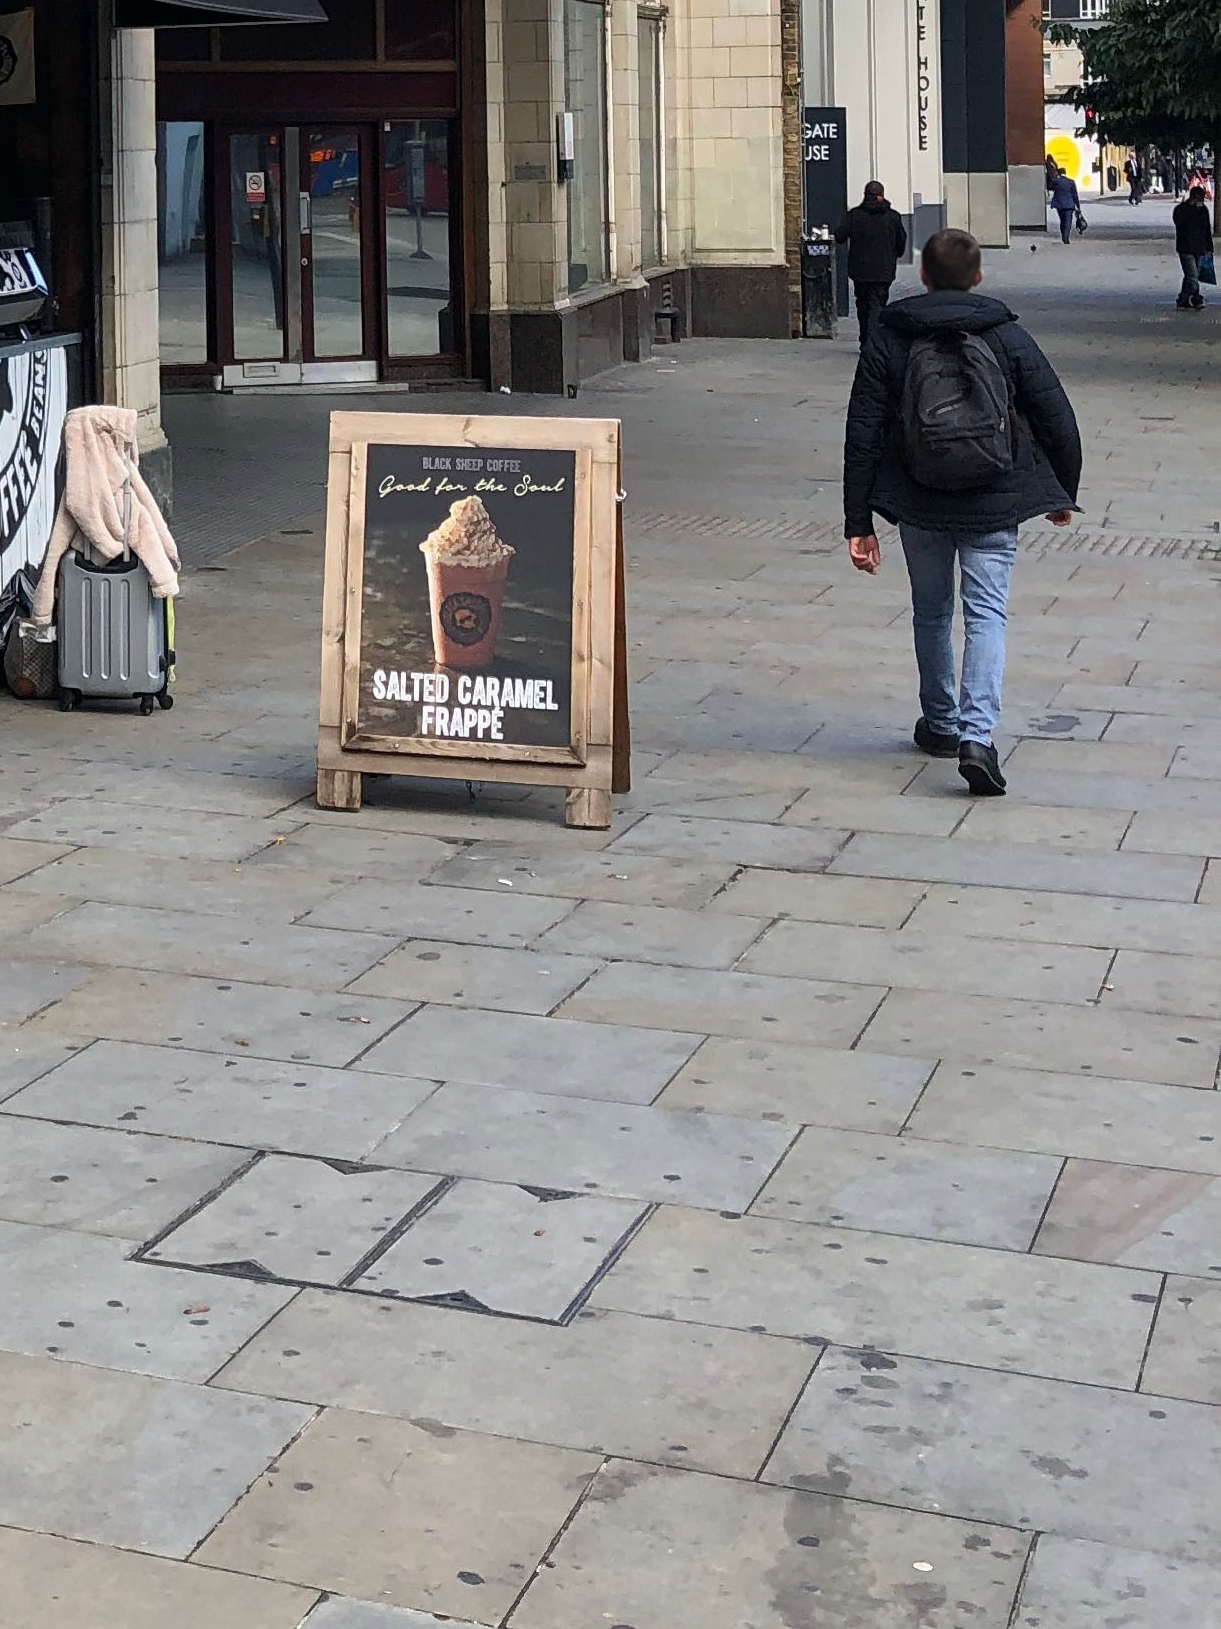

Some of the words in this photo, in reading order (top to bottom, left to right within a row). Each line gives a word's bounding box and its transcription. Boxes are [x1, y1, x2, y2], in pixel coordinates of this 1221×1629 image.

[918, 56, 929, 151] HOUSE
[31, 350, 47, 438] BEANS
[423, 457, 451, 470] BLACK
[456, 458, 483, 471] SHEEP
[487, 460, 521, 472] COFFEE
[378, 475, 430, 498] Good
[435, 477, 467, 495] for
[474, 478, 507, 492] the
[514, 474, 565, 497] Soul
[372, 670, 449, 703] SALTED
[457, 675, 559, 710] CARAMEL
[421, 705, 505, 740] FRAPPÉ
